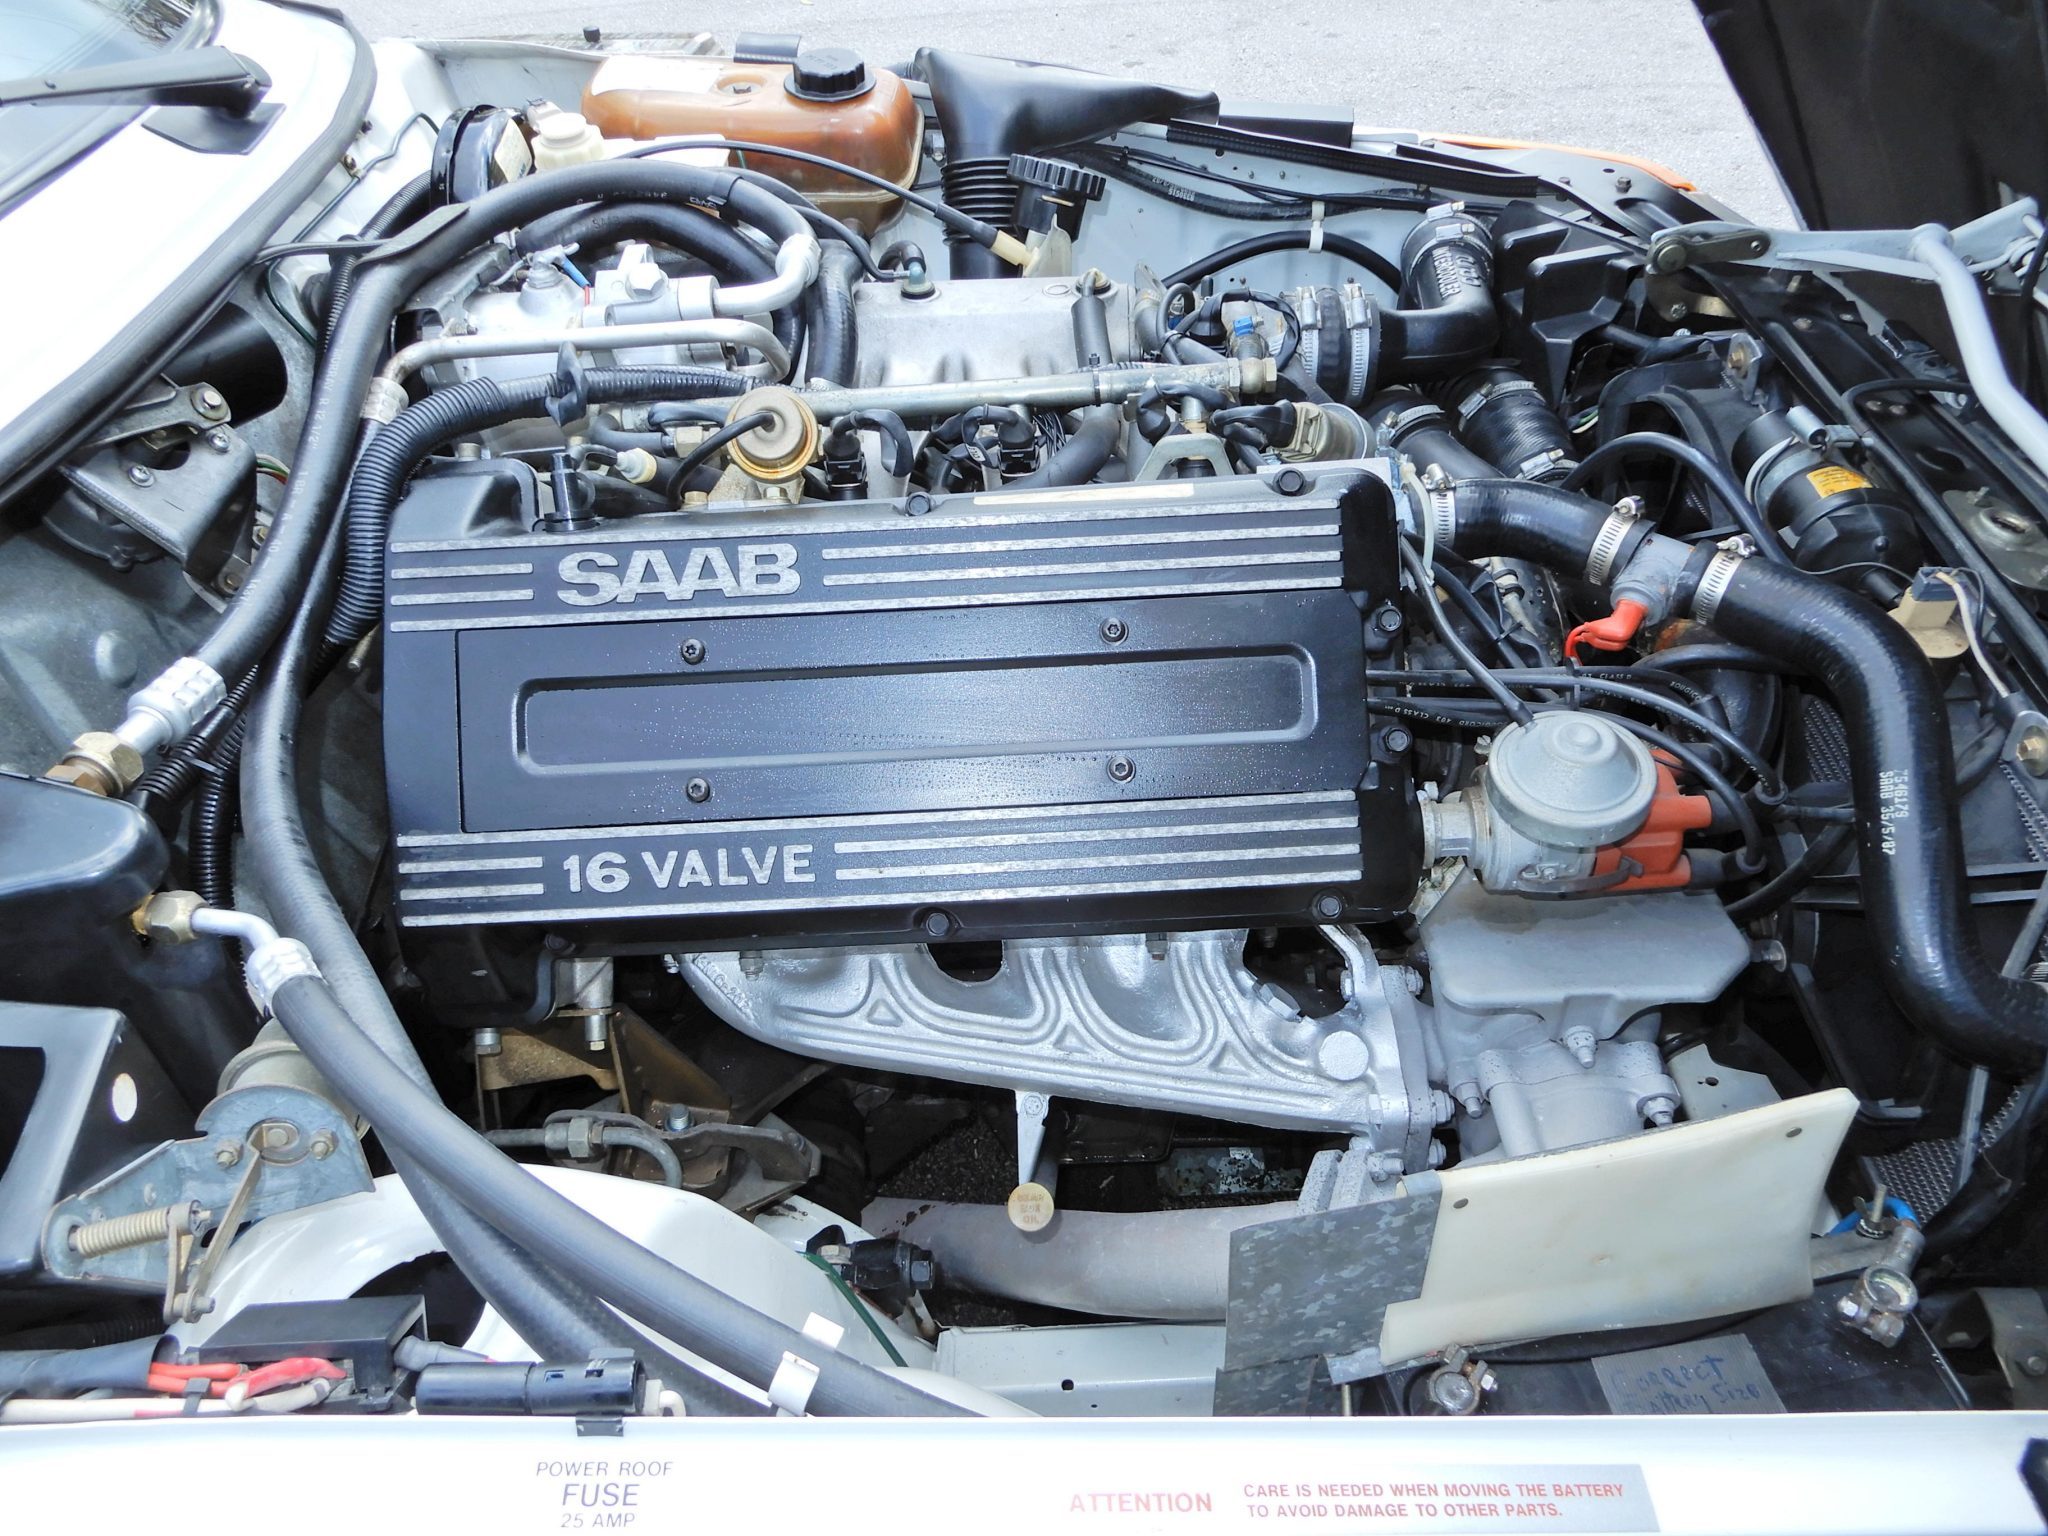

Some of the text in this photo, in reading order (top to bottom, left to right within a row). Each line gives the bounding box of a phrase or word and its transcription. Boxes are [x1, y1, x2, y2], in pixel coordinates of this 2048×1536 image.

[557, 543, 801, 606] SAAB
[1403, 708, 1430, 719] CLASS
[1879, 771, 1895, 799] SAAB
[1894, 768, 1910, 818] 7546179
[563, 844, 816, 893] 16 VALVE
[536, 1461, 674, 1477] POWER ROOF
[562, 1482, 640, 1507] FUSE
[1243, 1484, 1624, 1498] CARE IS NEEDED WHEN MOVING THE BATTERY
[1069, 1493, 1213, 1513] ATTENTION
[1247, 1503, 1563, 1518] TO AVOID DAMAGE TO OTHER PARTS.
[560, 1512, 635, 1529] 25 AMP
